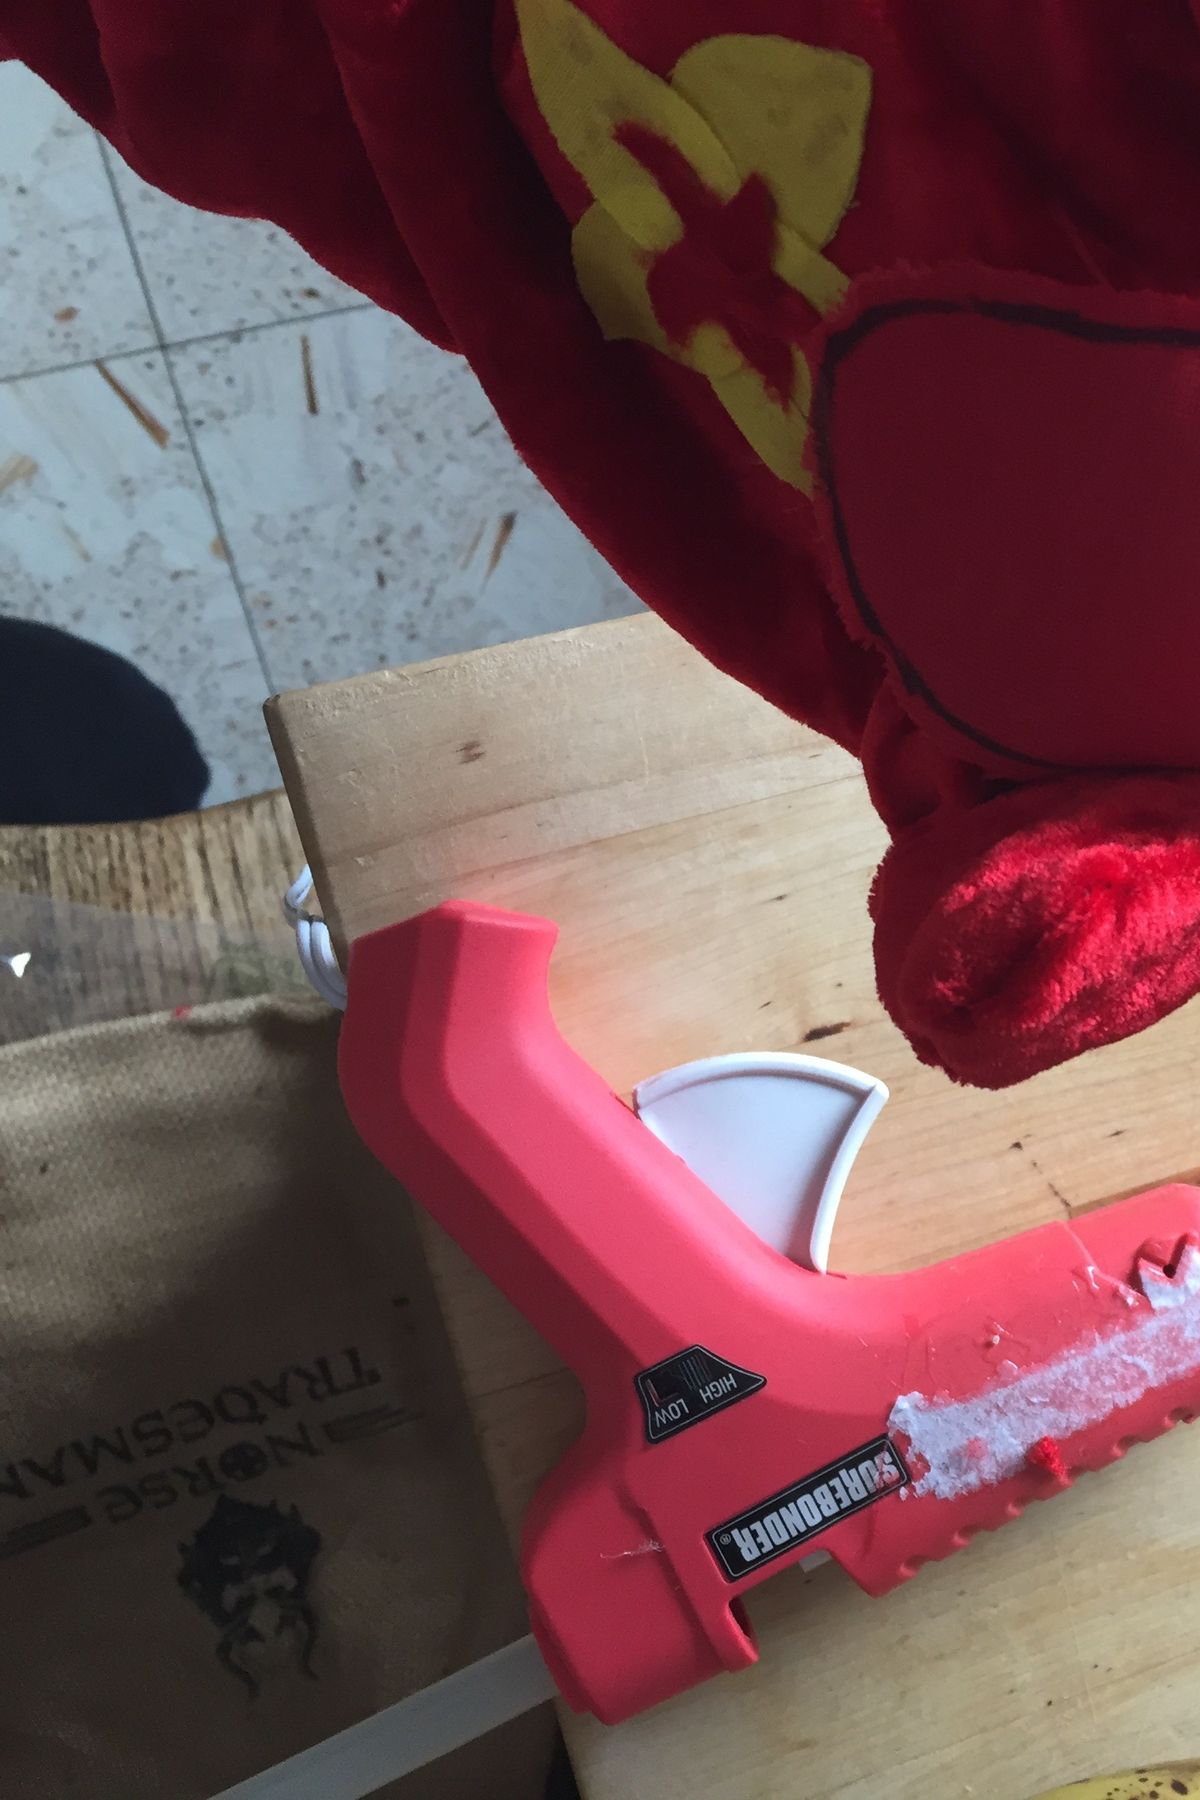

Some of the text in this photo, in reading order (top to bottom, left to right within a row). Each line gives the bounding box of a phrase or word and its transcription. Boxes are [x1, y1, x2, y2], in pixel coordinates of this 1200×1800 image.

[654, 1373, 738, 1428] HIGH LOW
[95, 1421, 325, 1524] NORSE
[730, 1451, 901, 1562] SUREBONDER
